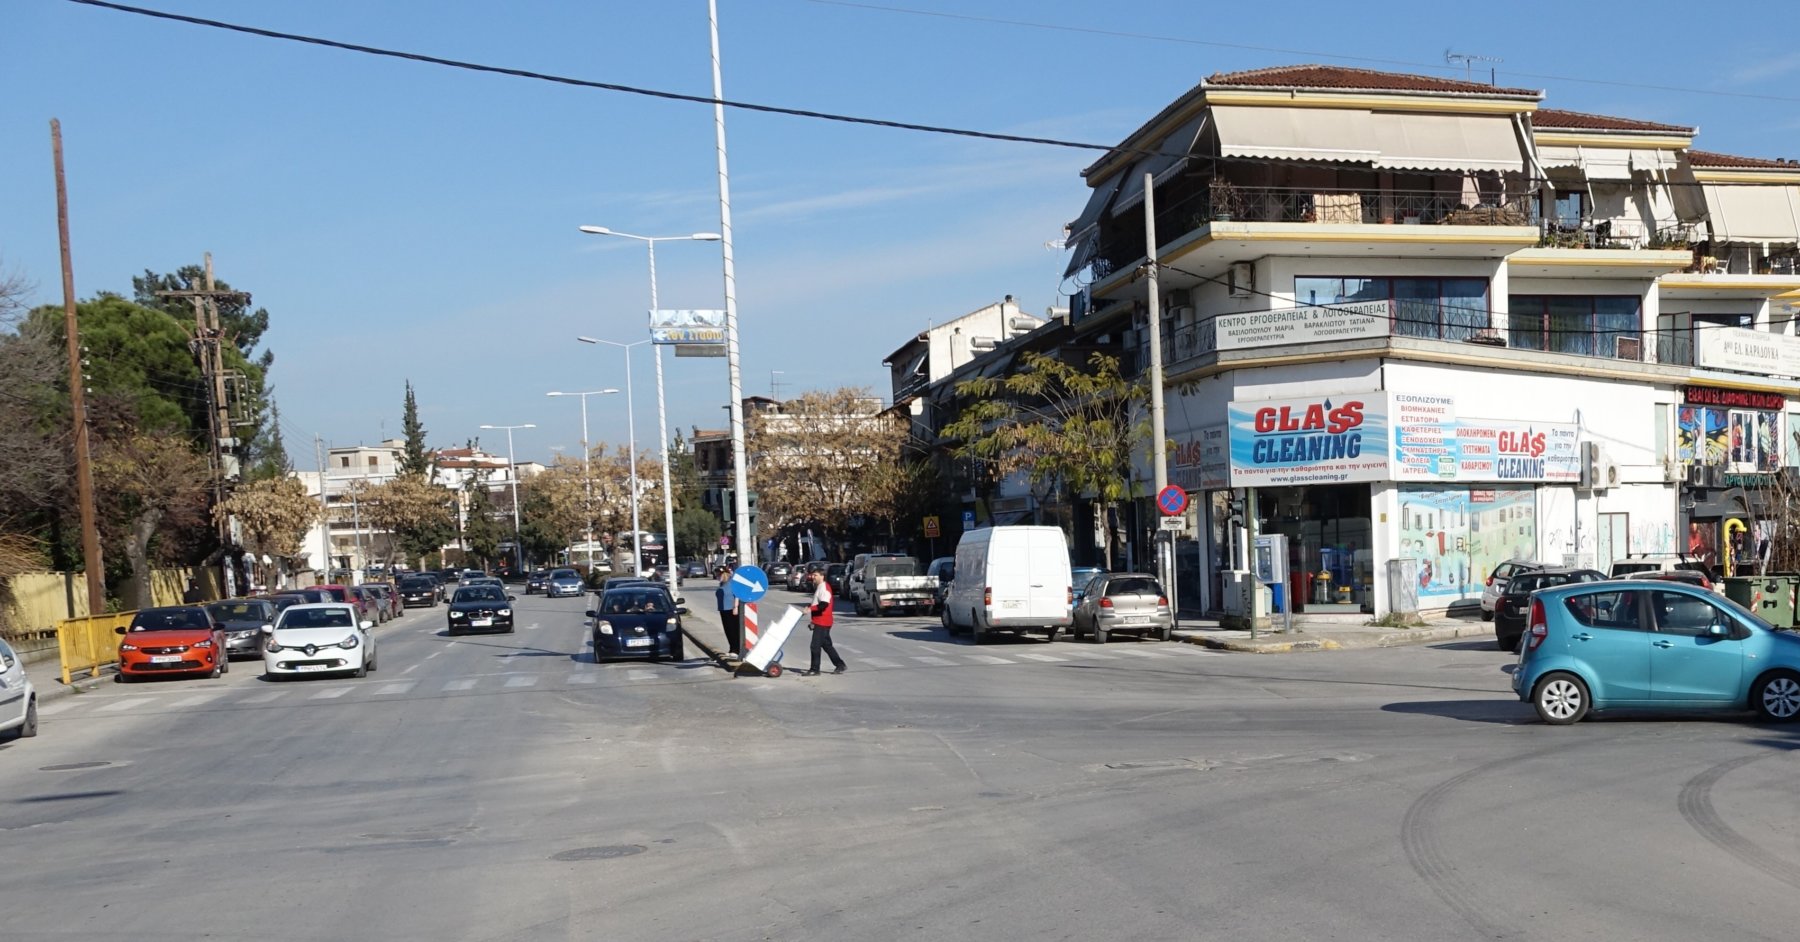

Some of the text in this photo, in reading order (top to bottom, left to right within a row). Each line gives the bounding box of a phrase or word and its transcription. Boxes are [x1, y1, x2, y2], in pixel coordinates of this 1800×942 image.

[1219, 304, 1386, 328] ΚΕΝΤΡΟ ΕΡΓΟΘΕΡΑΠΕΙΑΣ & ΛΟΓΟΘΕΡΑΠΕΙΑΣ
[1228, 324, 1294, 336] ΒΑΣΙΛΟΠΟΥΛΟΥ ΜΑΡΙΑ
[1314, 327, 1366, 336] ΛΟΓΟΘΕΡΑΠΕΥΤΡΙΑ
[1238, 334, 1284, 343] ΕΡΓΟΘΕΡΑΠΕΥΤΡΙΑ
[1396, 395, 1454, 405] ΕΞΟΠΛΙΖΟΥΜΕ:
[1400, 405, 1445, 414] ΒΙΟΜΗΧΑΝΙΕΣ
[1255, 401, 1364, 434] GLASS
[1402, 426, 1441, 434] ΚΑΦΕΤΕΡΙΕΣ
[1457, 428, 1496, 438] ΟΛΟΚΛΗΡΩΜΕΝΑ
[1252, 433, 1362, 464] CLEANING
[1498, 430, 1546, 458] GLASS
[1463, 445, 1490, 454] ΣΥΣΤΗΜΑΤΑ
[1462, 461, 1492, 470] ΚΑΘΑΡΙΣΜΟΥ
[1498, 458, 1545, 478] CLEANING
[1270, 473, 1348, 483] www.glasscleaning.gr
[966, 512, 972, 520] P
